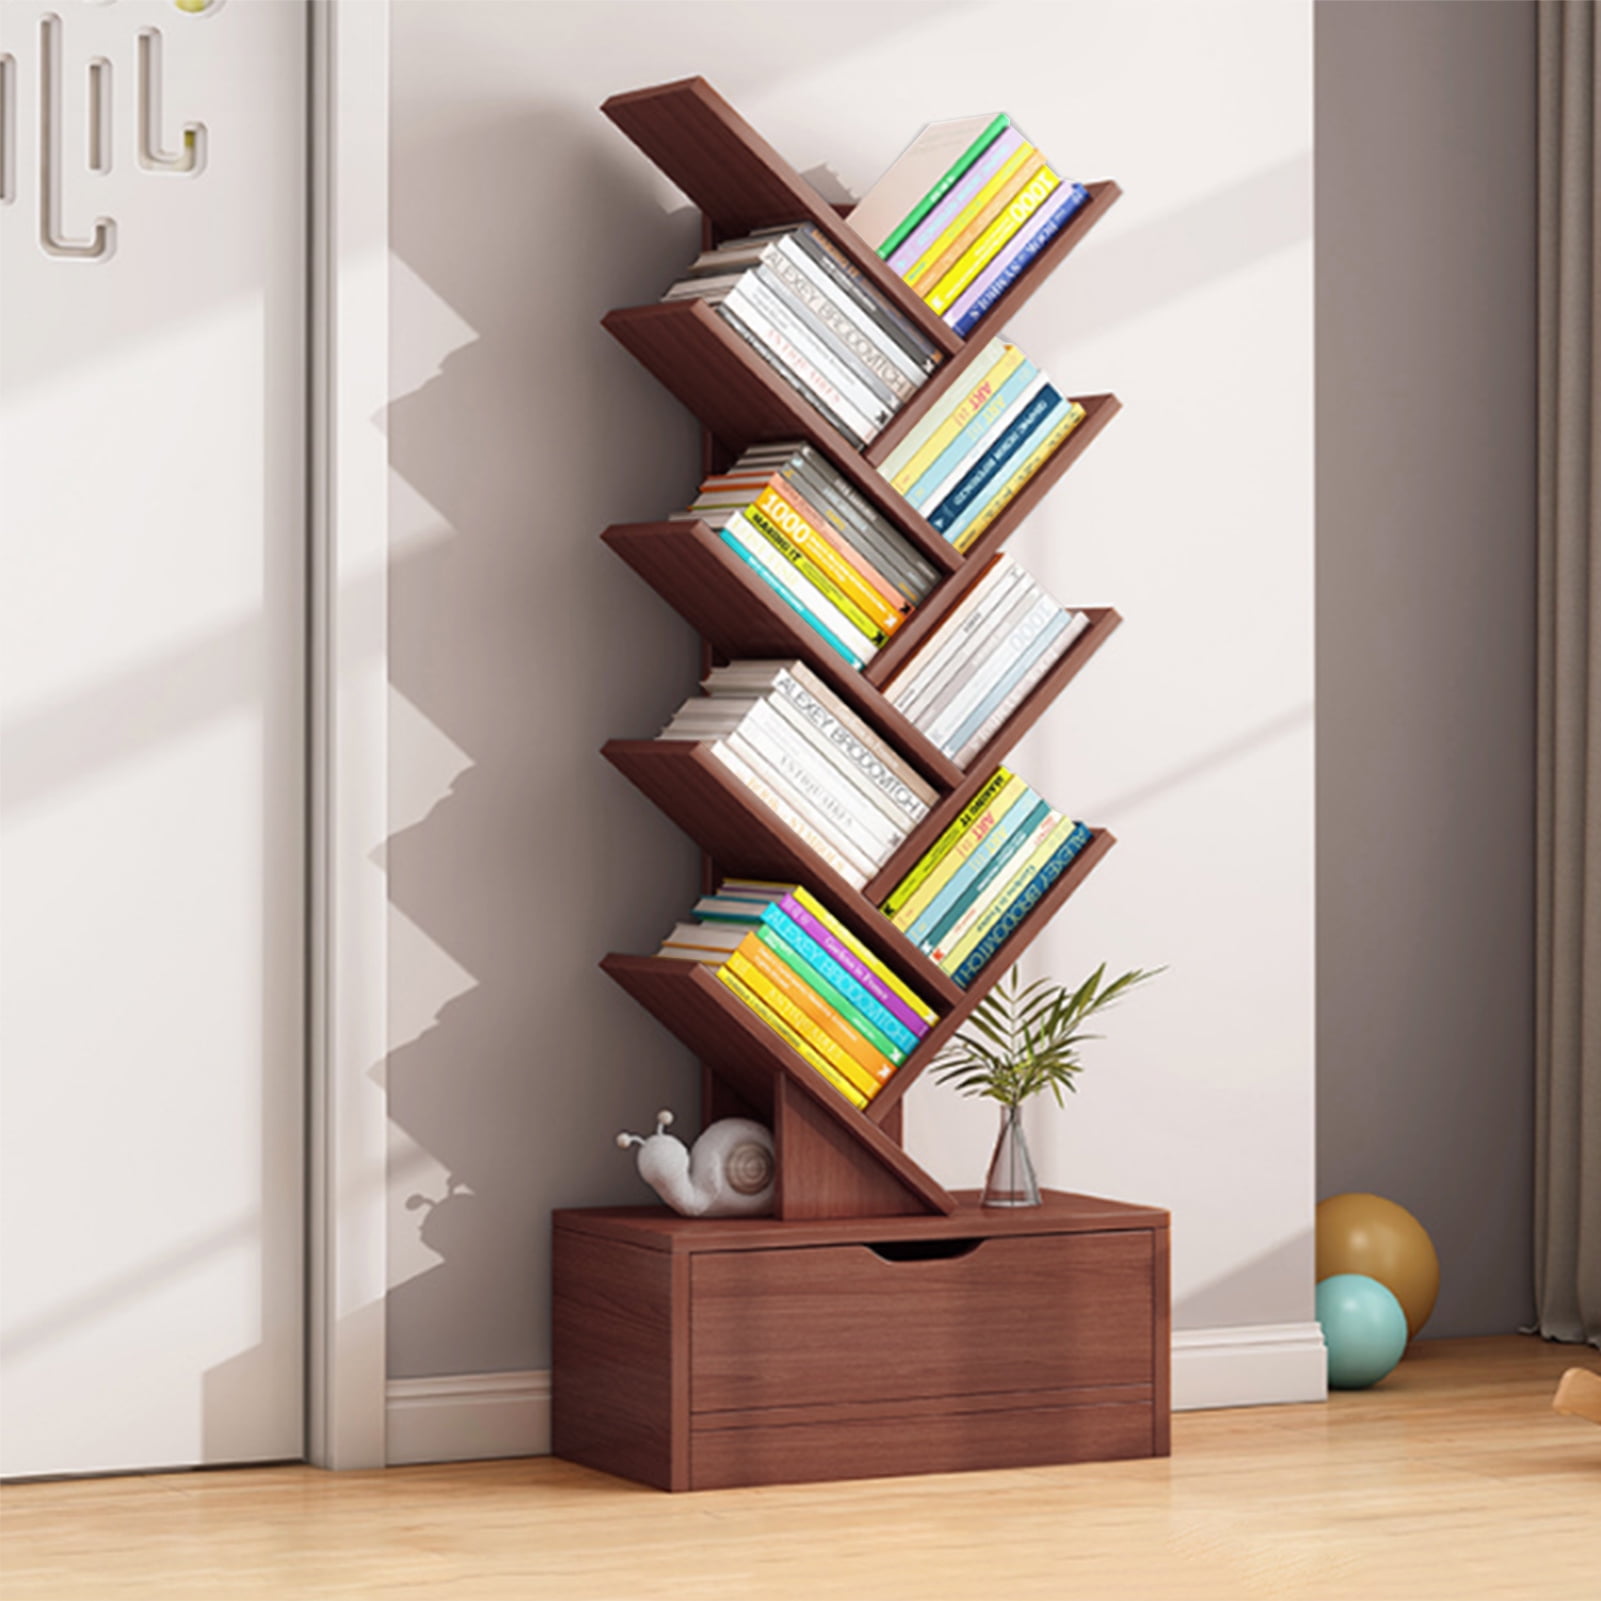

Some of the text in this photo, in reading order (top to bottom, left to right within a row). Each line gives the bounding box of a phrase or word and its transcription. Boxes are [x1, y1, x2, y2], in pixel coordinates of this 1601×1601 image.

[1006, 171, 1055, 223] 1000
[765, 247, 821, 304] ALEXEY
[964, 380, 994, 411] ART
[979, 394, 1008, 424] ART
[759, 492, 813, 544] 1000
[787, 548, 801, 562] IT
[1007, 602, 1053, 652] 1000
[776, 673, 921, 814] ALEXEY BRODOVITCH
[957, 812, 972, 827] IT
[969, 811, 997, 840] ART
[1038, 827, 1088, 885] ALEXEY
[957, 883, 1042, 982] BRODOVITCH
[766, 908, 823, 964] ALEXEY
[818, 960, 907, 1046] BRODOVITCH
